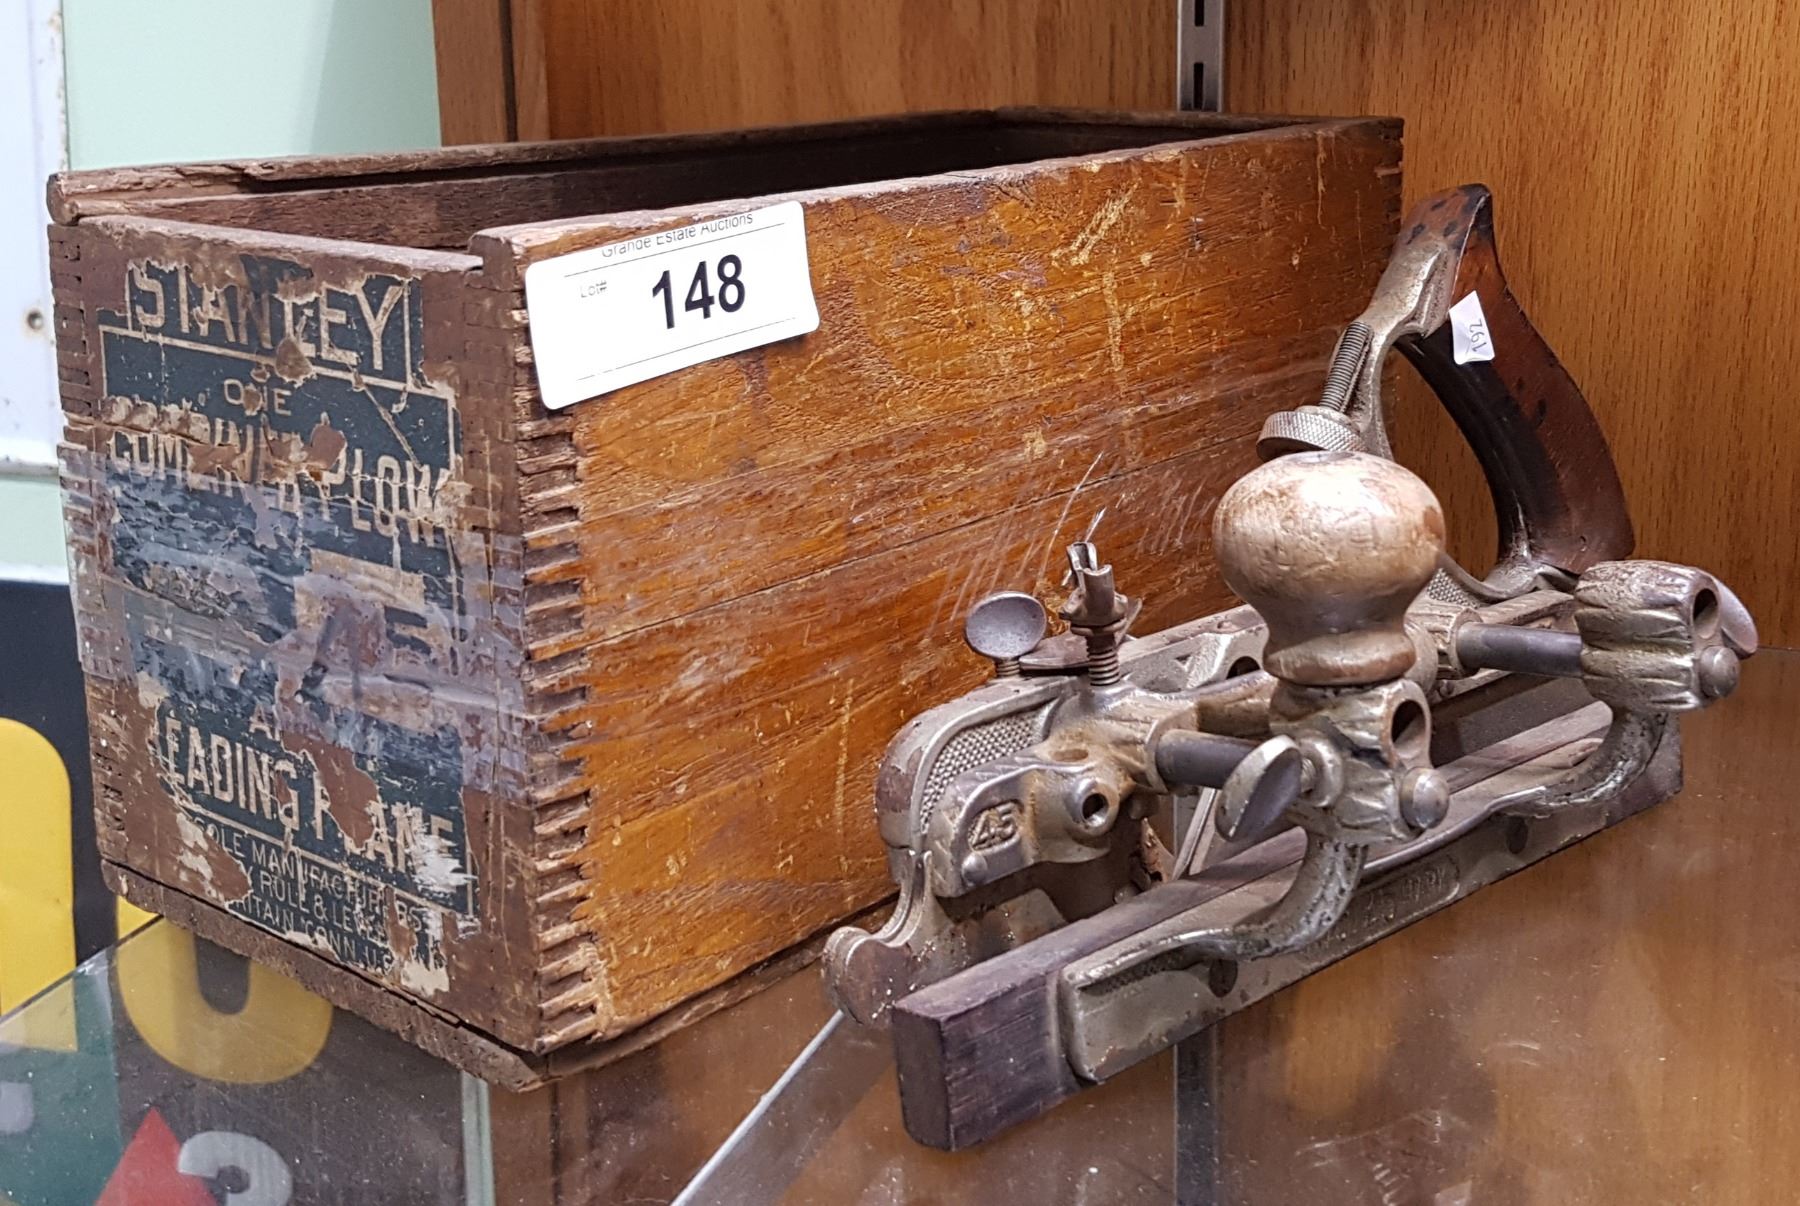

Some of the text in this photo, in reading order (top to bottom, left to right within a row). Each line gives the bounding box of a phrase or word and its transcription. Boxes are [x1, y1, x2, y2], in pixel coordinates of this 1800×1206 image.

[601, 211, 753, 258] Grande Estate Auctions
[132, 264, 405, 372] STANLEY
[652, 253, 746, 330] 148
[162, 715, 300, 832] EADING
